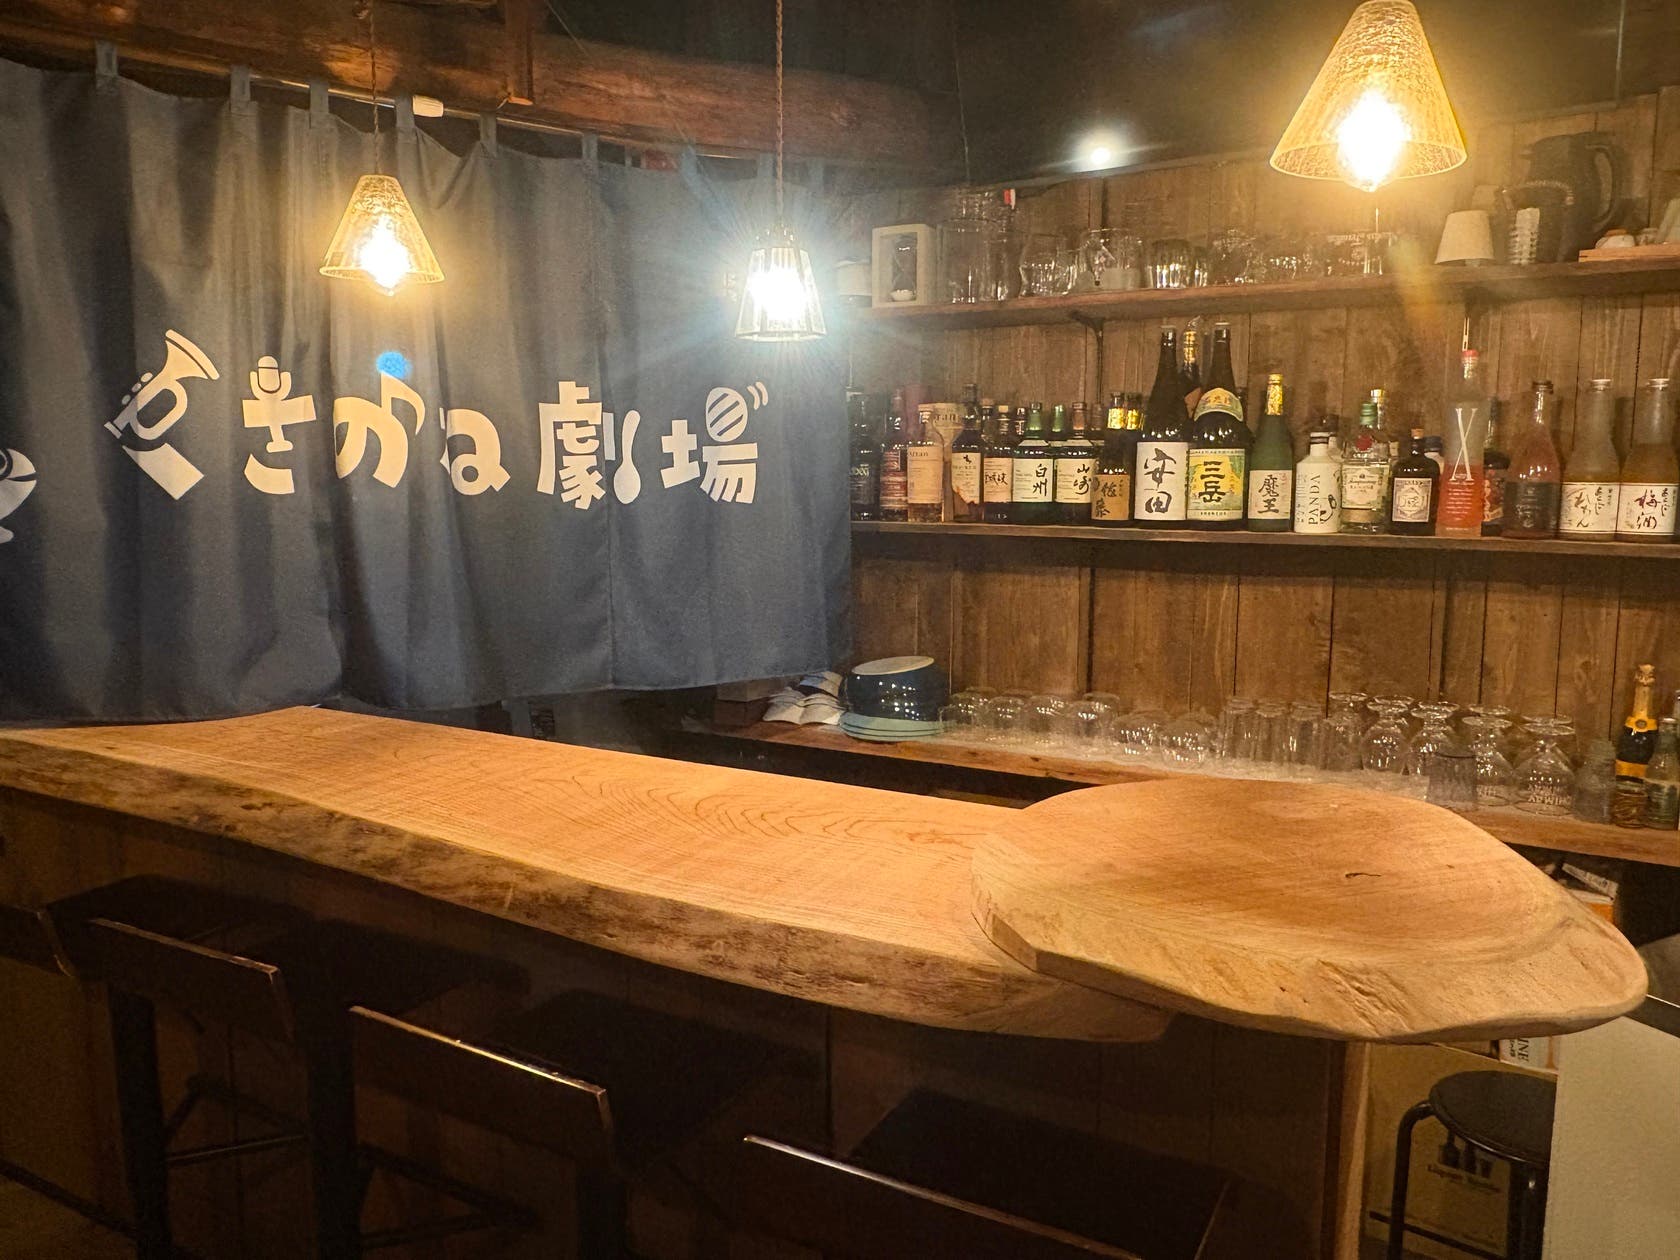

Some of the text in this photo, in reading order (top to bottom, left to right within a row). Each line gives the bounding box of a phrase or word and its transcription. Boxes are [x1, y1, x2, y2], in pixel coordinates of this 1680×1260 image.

[1032, 463, 1048, 497] 白州
[1143, 447, 1177, 514] 安田
[1198, 460, 1226, 503] 三岳
[1257, 474, 1280, 513] 魔王
[1308, 474, 1320, 525] PANDA
[1634, 489, 1661, 530] 梅酒
